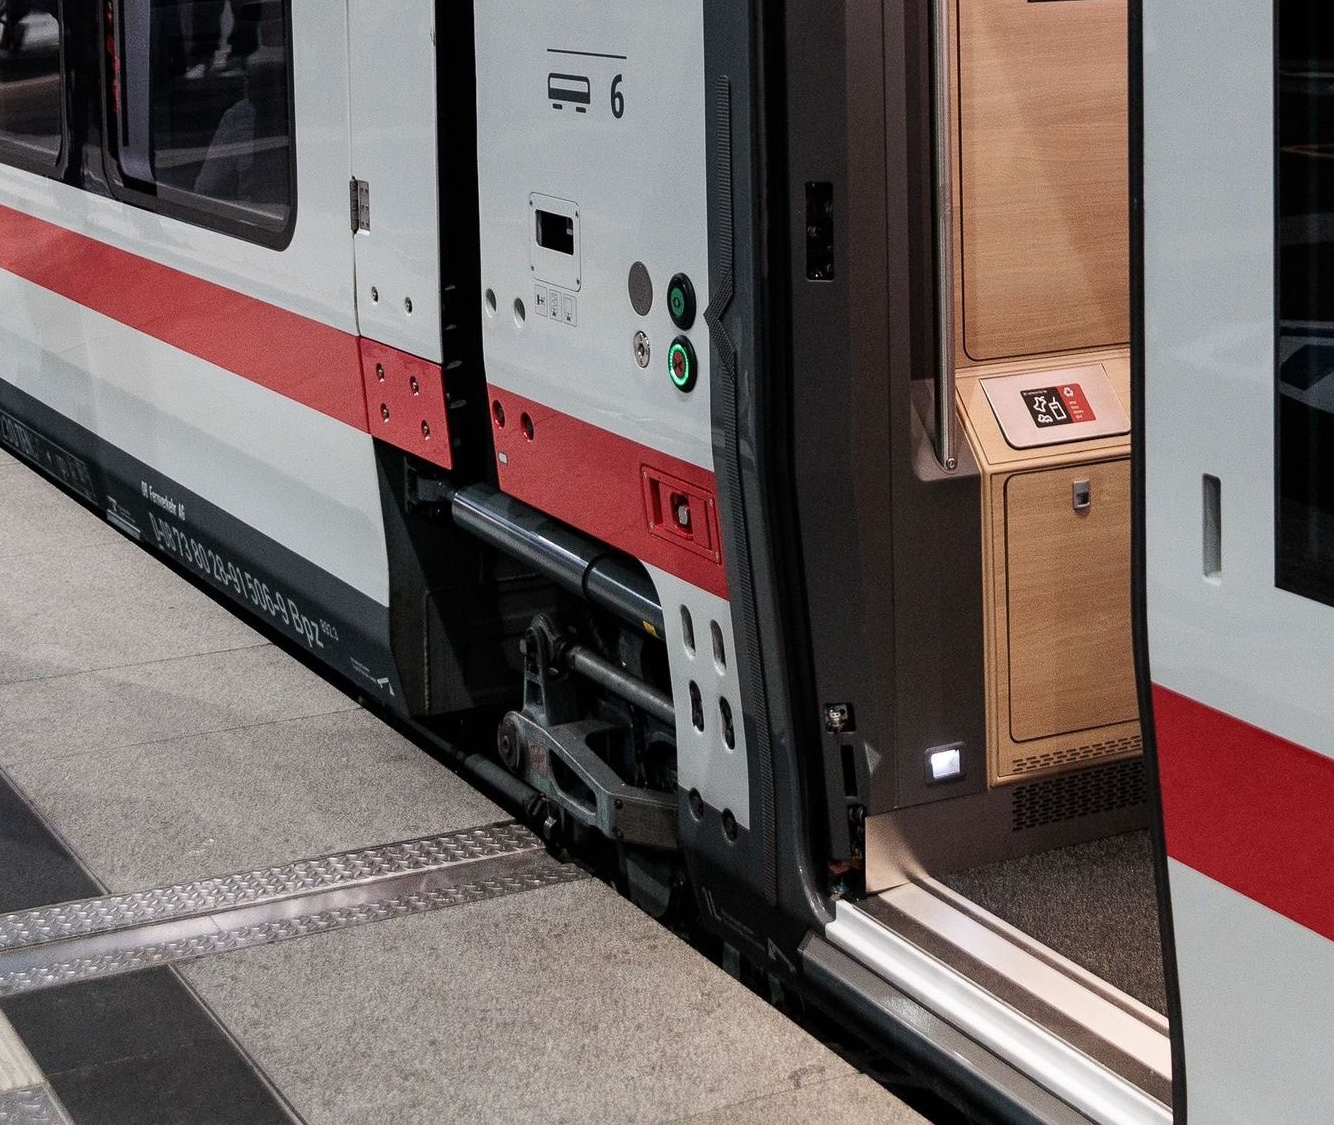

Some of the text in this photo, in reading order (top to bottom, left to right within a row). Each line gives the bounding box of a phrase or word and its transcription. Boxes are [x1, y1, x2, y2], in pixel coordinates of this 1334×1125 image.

[610, 73, 625, 120] 6
[172, 526, 193, 563] 73
[190, 538, 211, 574] 80
[244, 571, 290, 626] 506-9
[287, 598, 325, 649] Bpz
